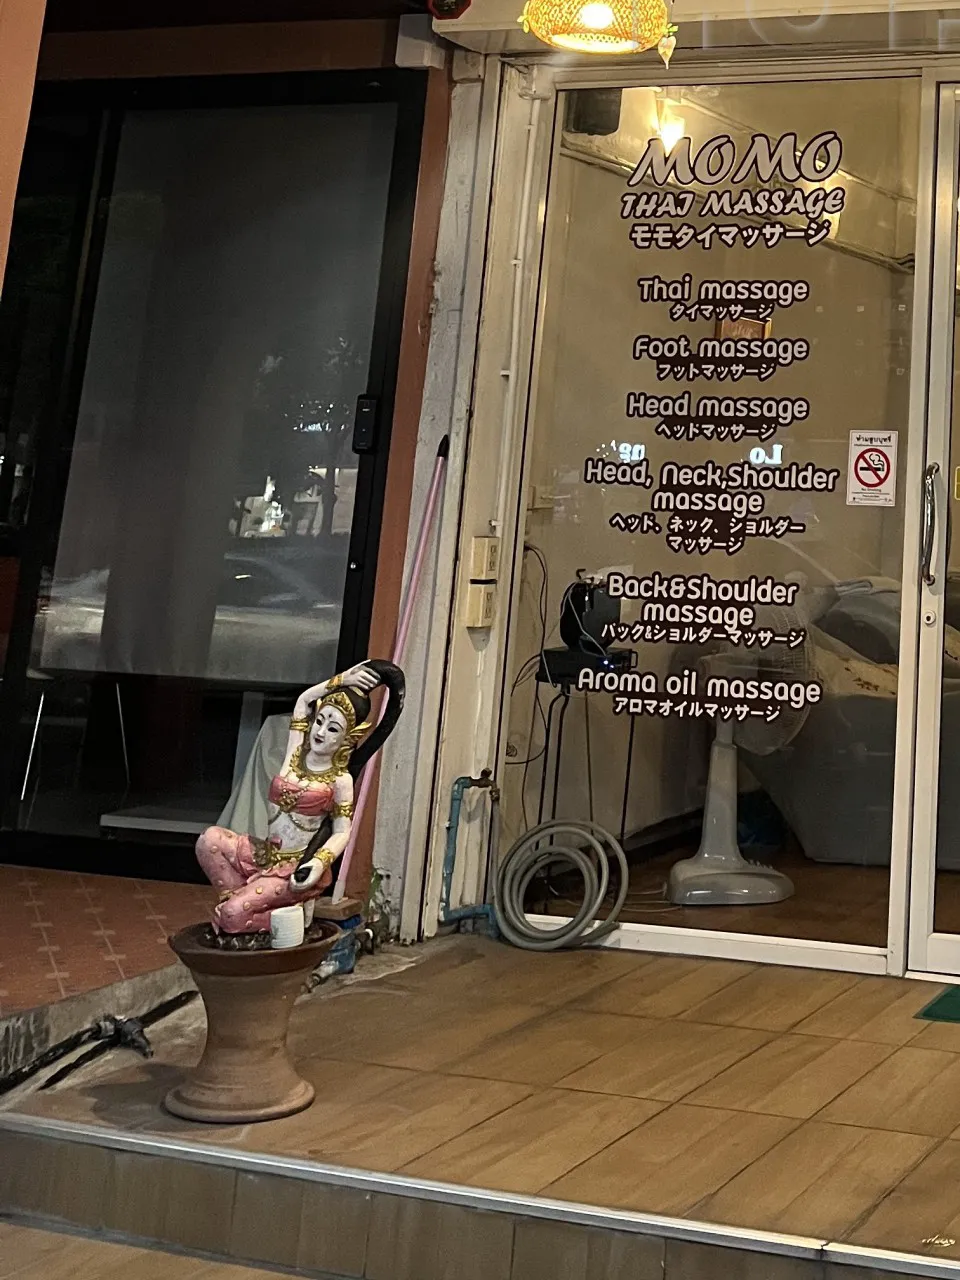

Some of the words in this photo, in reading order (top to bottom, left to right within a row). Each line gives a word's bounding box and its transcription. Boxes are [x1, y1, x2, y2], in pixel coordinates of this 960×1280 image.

[629, 131, 842, 187] MOMO
[620, 192, 696, 218] THAI
[700, 187, 845, 217] MASSAGE
[630, 221, 831, 249] モモタイマッサージ
[639, 275, 691, 303] Thai
[699, 278, 809, 307] massage
[671, 303, 774, 320] タイマッサージ
[634, 337, 689, 359] Foot
[699, 339, 809, 365] massage
[657, 363, 776, 381] フットマッサージ
[628, 392, 690, 418] Head
[699, 396, 809, 423] massage
[656, 423, 776, 440] ヘッドマッサージ
[585, 459, 653, 488] Head,
[653, 490, 764, 518] massage
[668, 535, 744, 554] マッサージ
[607, 573, 799, 605] Back&Shoulder
[643, 600, 754, 632] massage
[576, 666, 657, 694] Aroma
[665, 670, 697, 697] oil
[706, 679, 821, 709] massage
[613, 695, 781, 722] アロマオイルマッサージ
